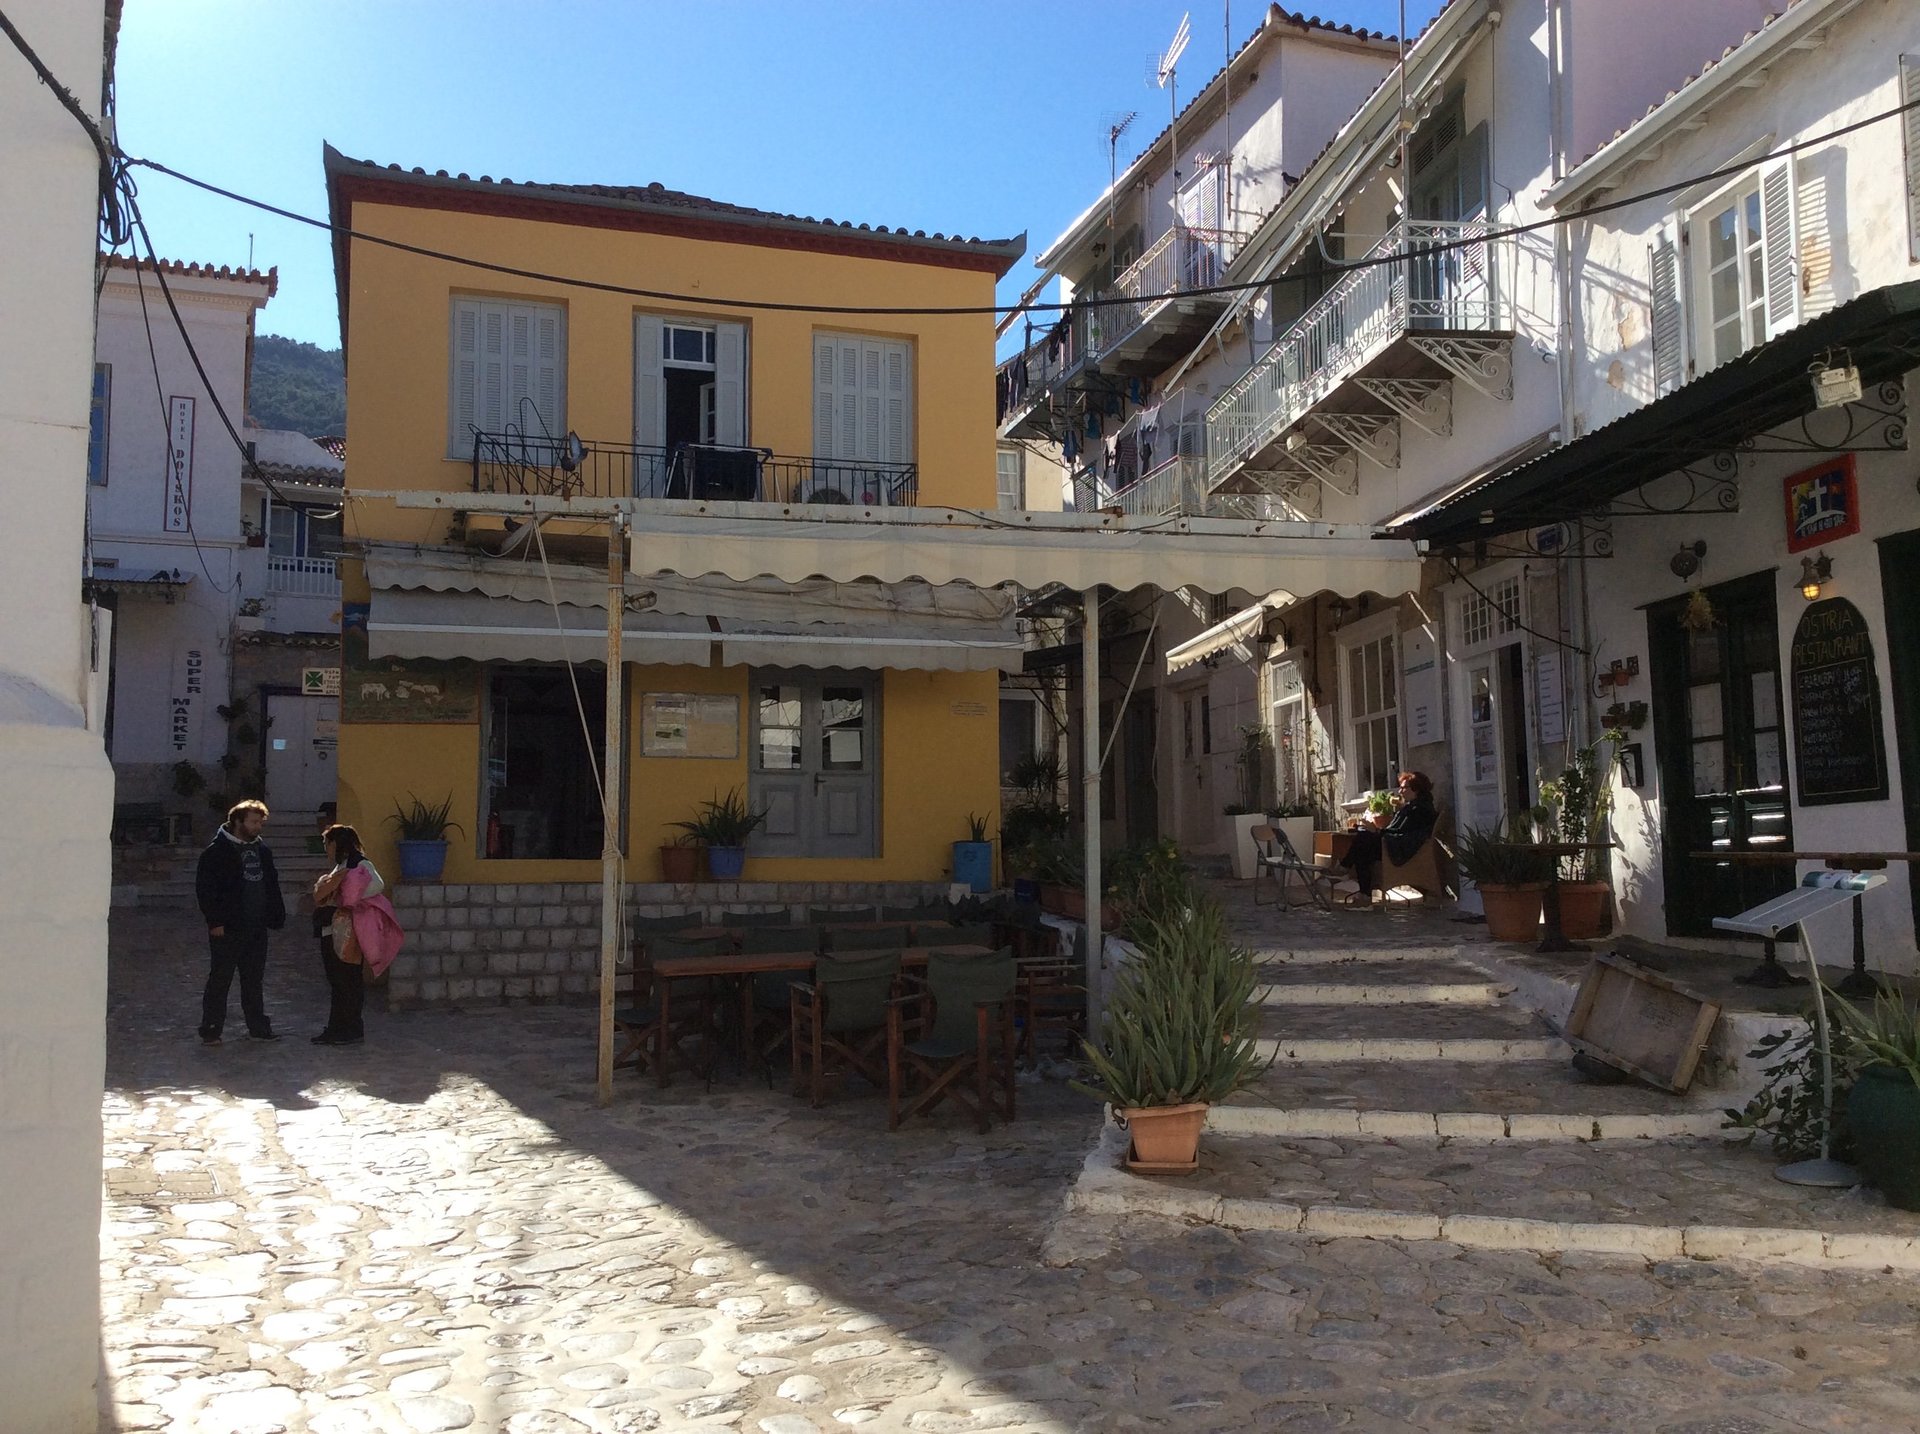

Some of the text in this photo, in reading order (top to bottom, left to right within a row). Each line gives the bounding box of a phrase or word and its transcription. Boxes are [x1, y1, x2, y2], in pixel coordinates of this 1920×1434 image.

[173, 449, 185, 527] DOUSKOS
[1801, 609, 1854, 639] OSTRIA
[172, 650, 202, 751] SUPER MARKET
